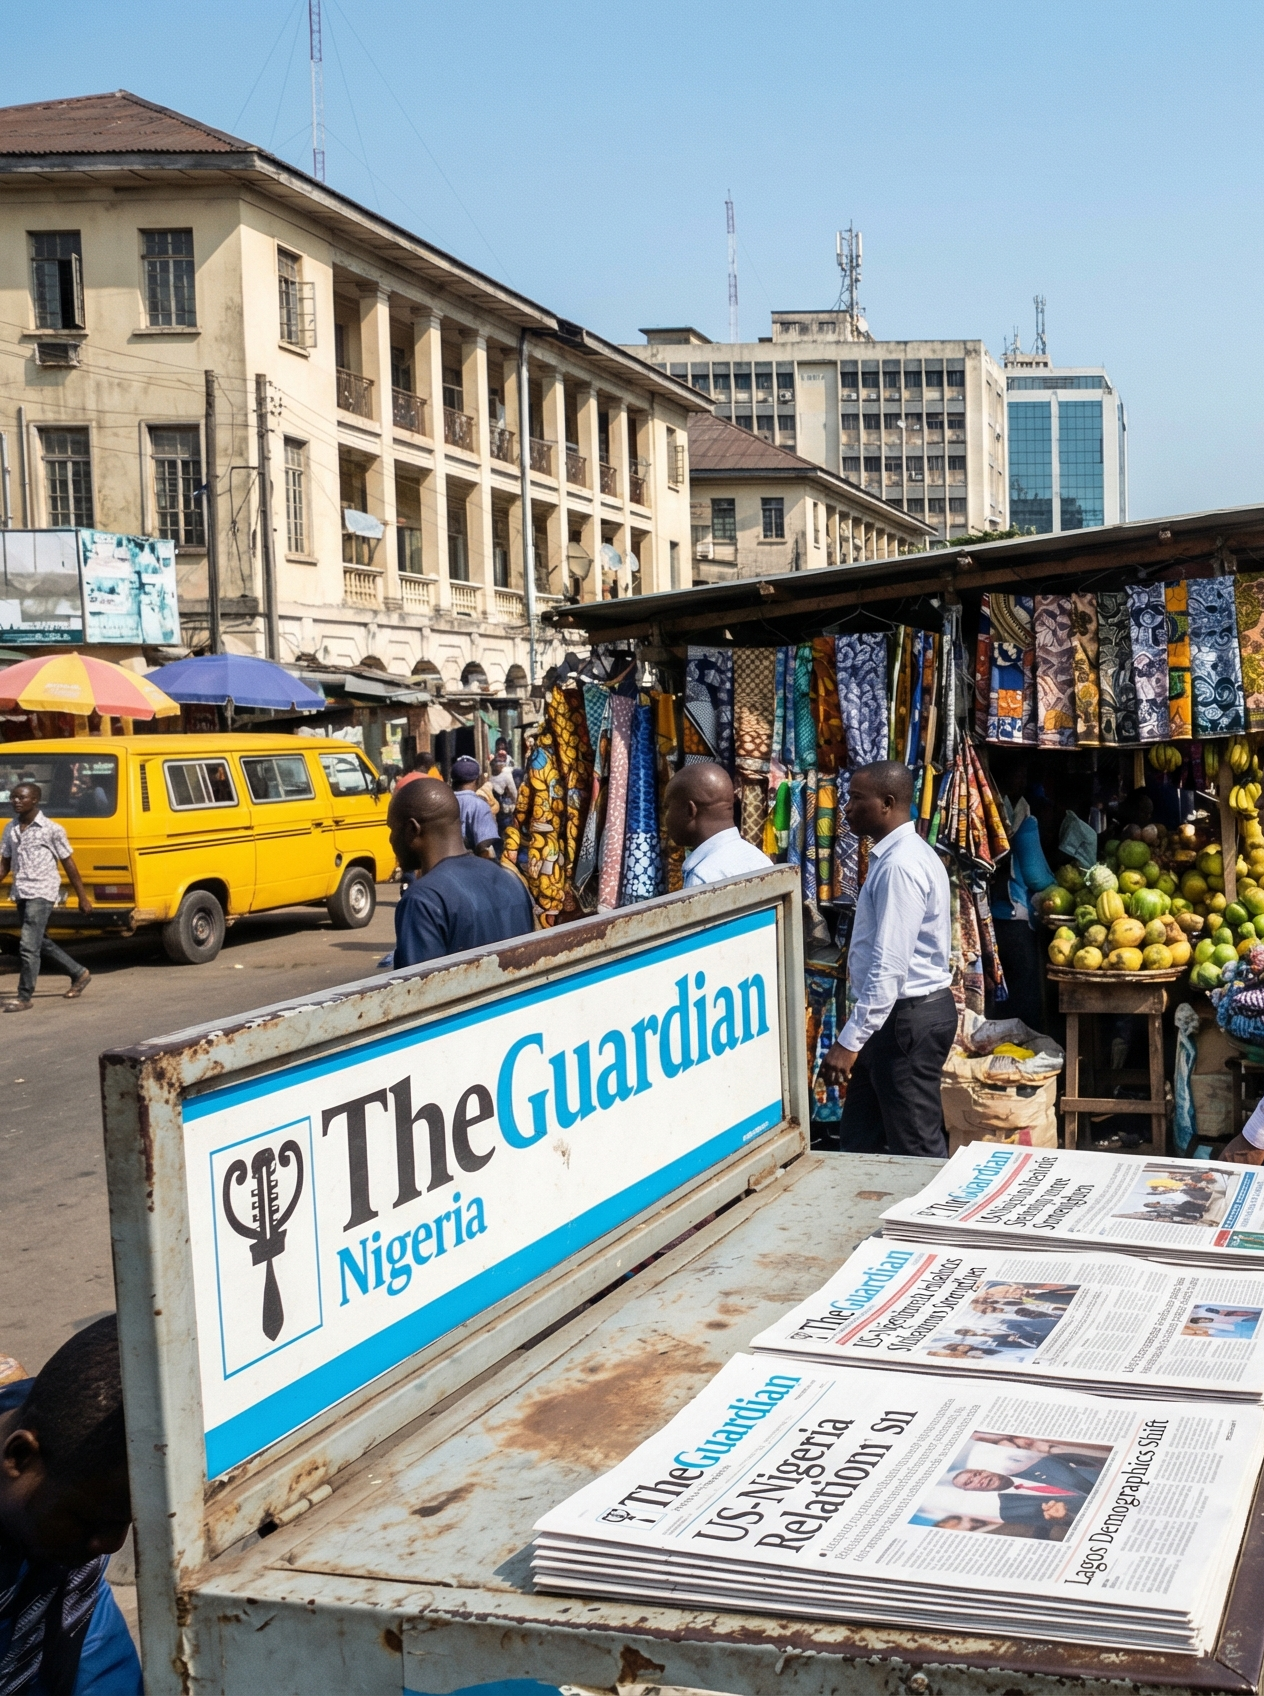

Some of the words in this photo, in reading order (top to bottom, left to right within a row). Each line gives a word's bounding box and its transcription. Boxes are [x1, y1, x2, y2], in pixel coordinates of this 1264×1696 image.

[336, 1191, 488, 1307] Nigeria
[692, 1417, 857, 1543] US-Nigeria
[1064, 1544, 1109, 1586] Lagos
[1088, 1449, 1157, 1545] Demographics
[1137, 1418, 1170, 1448] Shift
